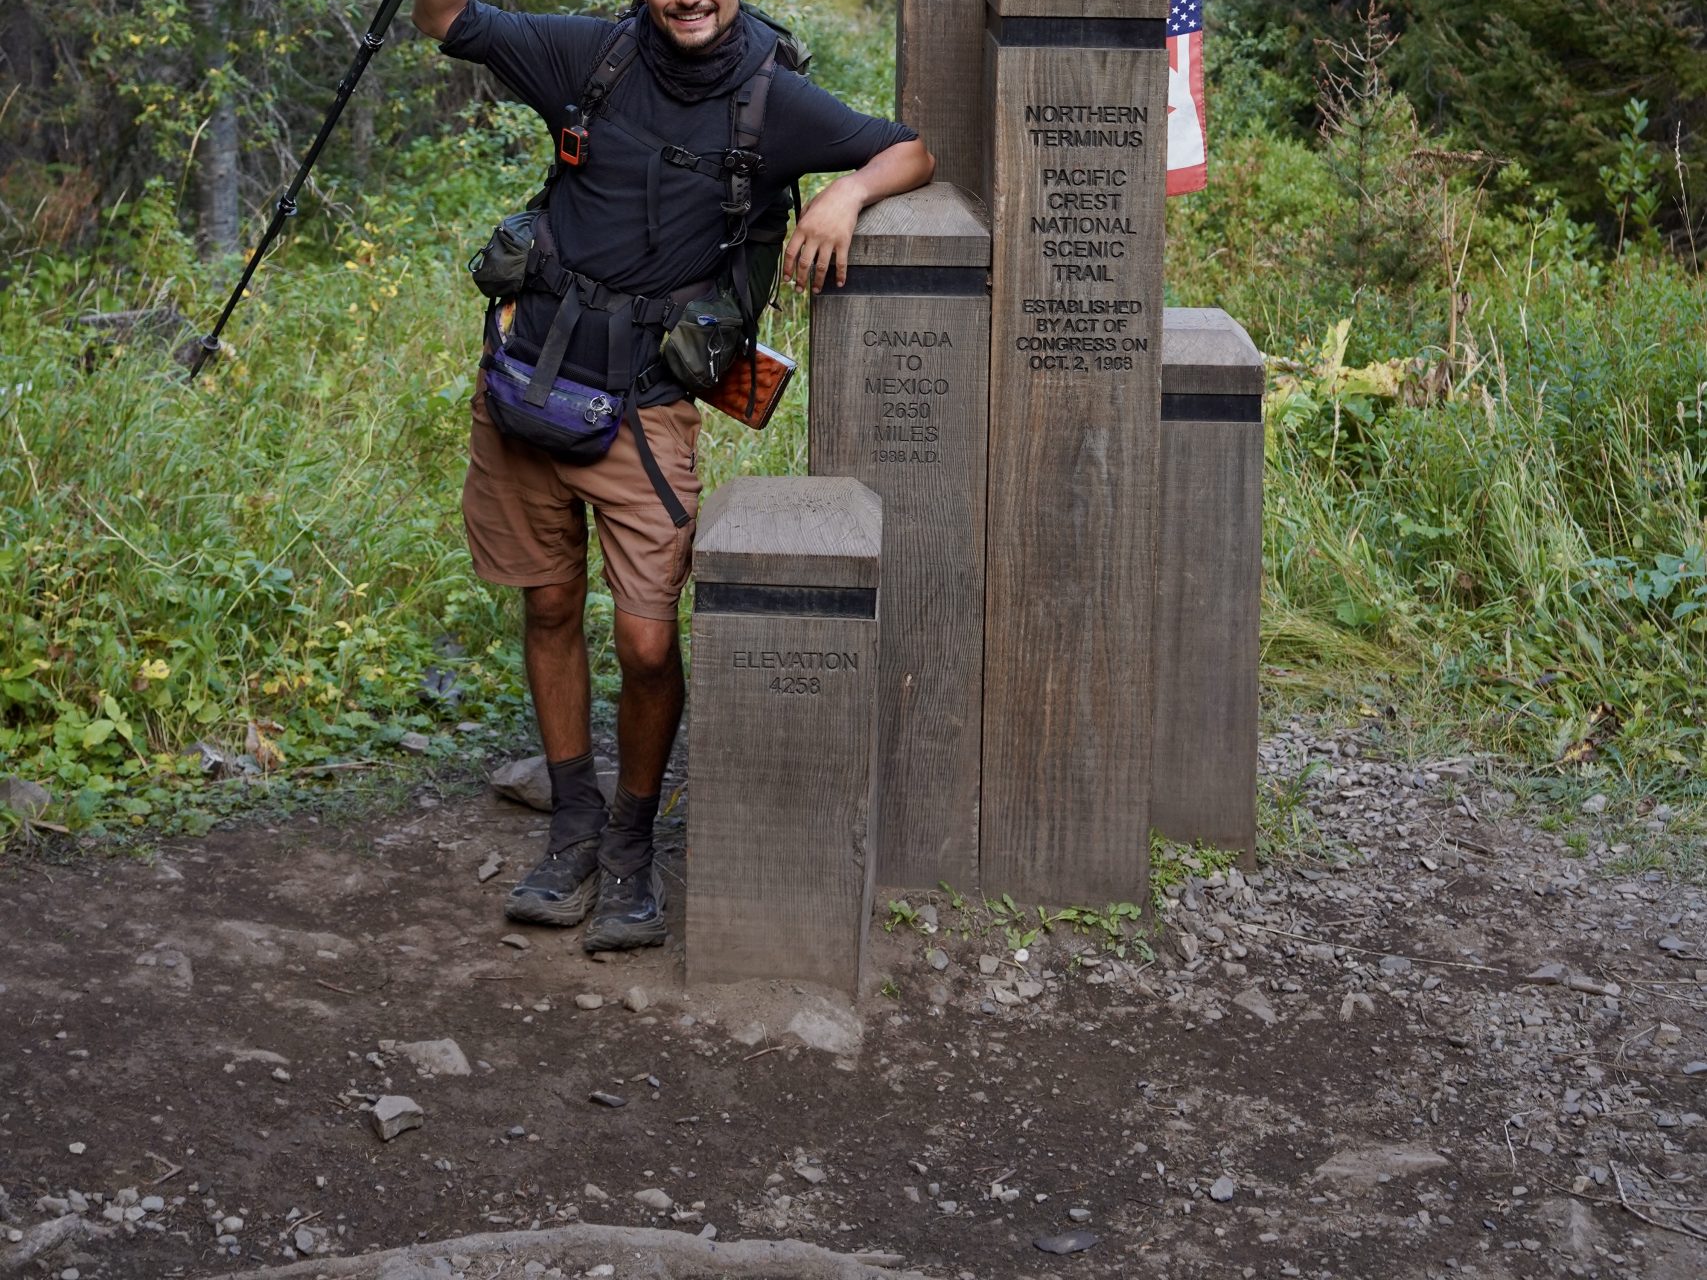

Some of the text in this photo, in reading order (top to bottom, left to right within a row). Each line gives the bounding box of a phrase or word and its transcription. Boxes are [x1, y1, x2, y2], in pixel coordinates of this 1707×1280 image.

[1025, 105, 1148, 124] NORTHERN
[1029, 129, 1143, 147] TERMINUS
[1043, 169, 1127, 186] PACIFIC
[1048, 192, 1122, 211] CREST
[1031, 216, 1137, 235] NATIONAL
[1043, 240, 1125, 258] SCENIC
[1052, 264, 1114, 282] TRAIL
[1022, 299, 1142, 315] ESTABLISHED
[1036, 319, 1128, 333] BY ACT OF
[863, 330, 953, 348] CANADA
[1016, 336, 1148, 352] CONGRESS ON
[893, 354, 922, 371] TO
[1029, 355, 1069, 371] OCT.
[1073, 356, 1089, 372] 2,
[864, 378, 949, 395] MEXICO
[882, 402, 931, 419] 2650
[874, 425, 938, 442] MILES
[909, 450, 941, 463] A.D.
[733, 651, 858, 671] ELEVATION
[769, 676, 821, 694] 4258
